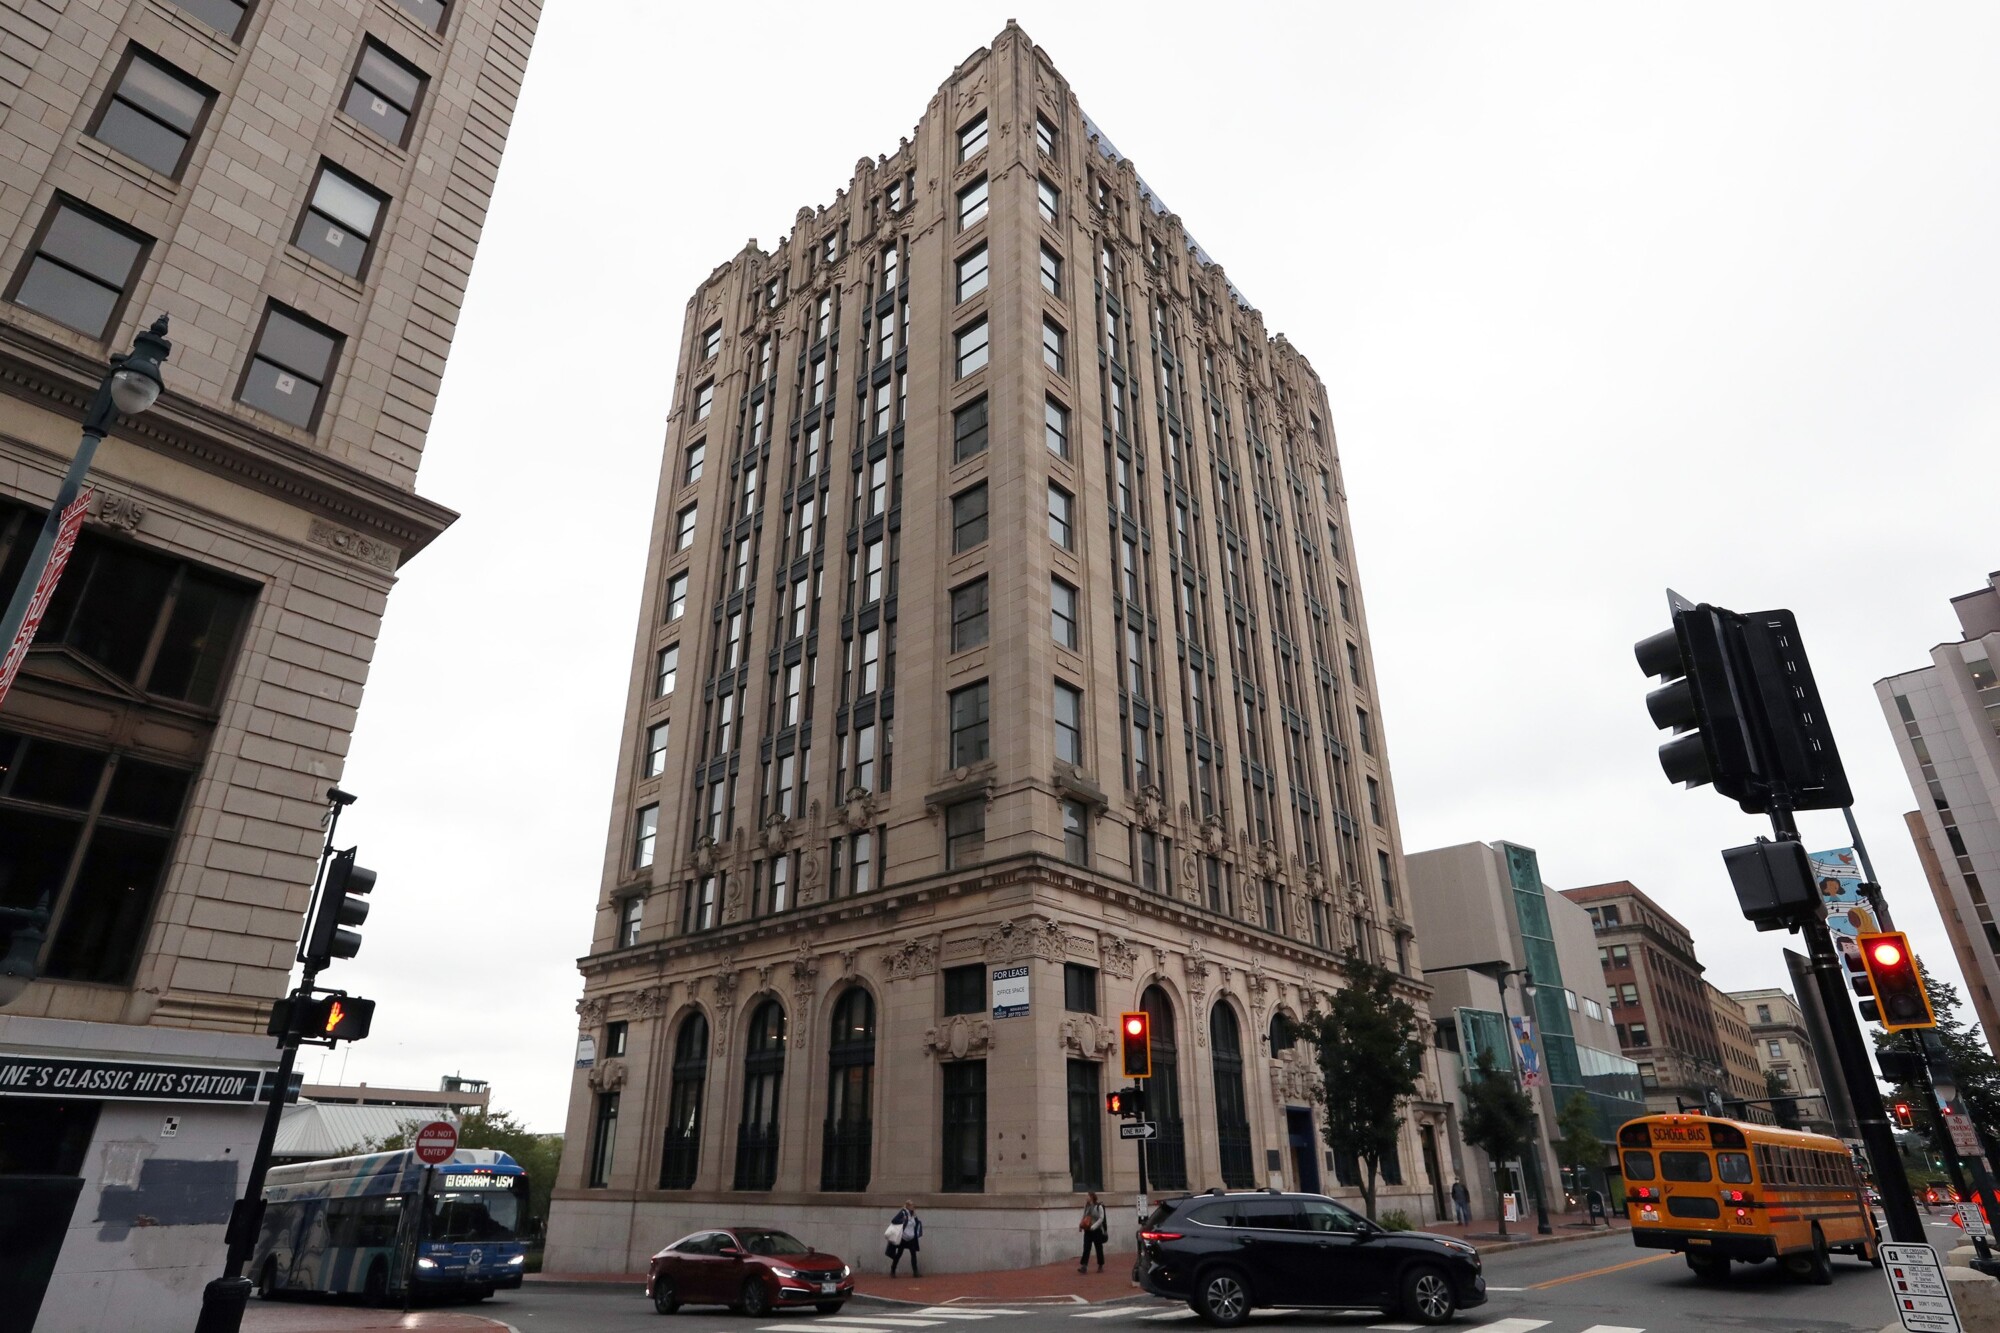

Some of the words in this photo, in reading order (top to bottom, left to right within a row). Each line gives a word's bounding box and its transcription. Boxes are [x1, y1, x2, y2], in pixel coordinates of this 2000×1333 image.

[993, 970, 1008, 980] FOR
[1008, 967, 1028, 978] LEASE
[996, 988, 1011, 996] OFFICE
[53, 1067, 133, 1090] CLASSIC
[133, 1072, 177, 1092] HITS
[177, 1074, 247, 1095] STATION
[1953, 1116, 1963, 1125] NO
[1653, 1127, 1687, 1140] SCHOOL
[1687, 1127, 1706, 1140] BUS
[423, 1148, 447, 1156] ENTER
[455, 1175, 490, 1188] GORHAM
[495, 1175, 515, 1188] USM
[1735, 1217, 1753, 1226] 103
